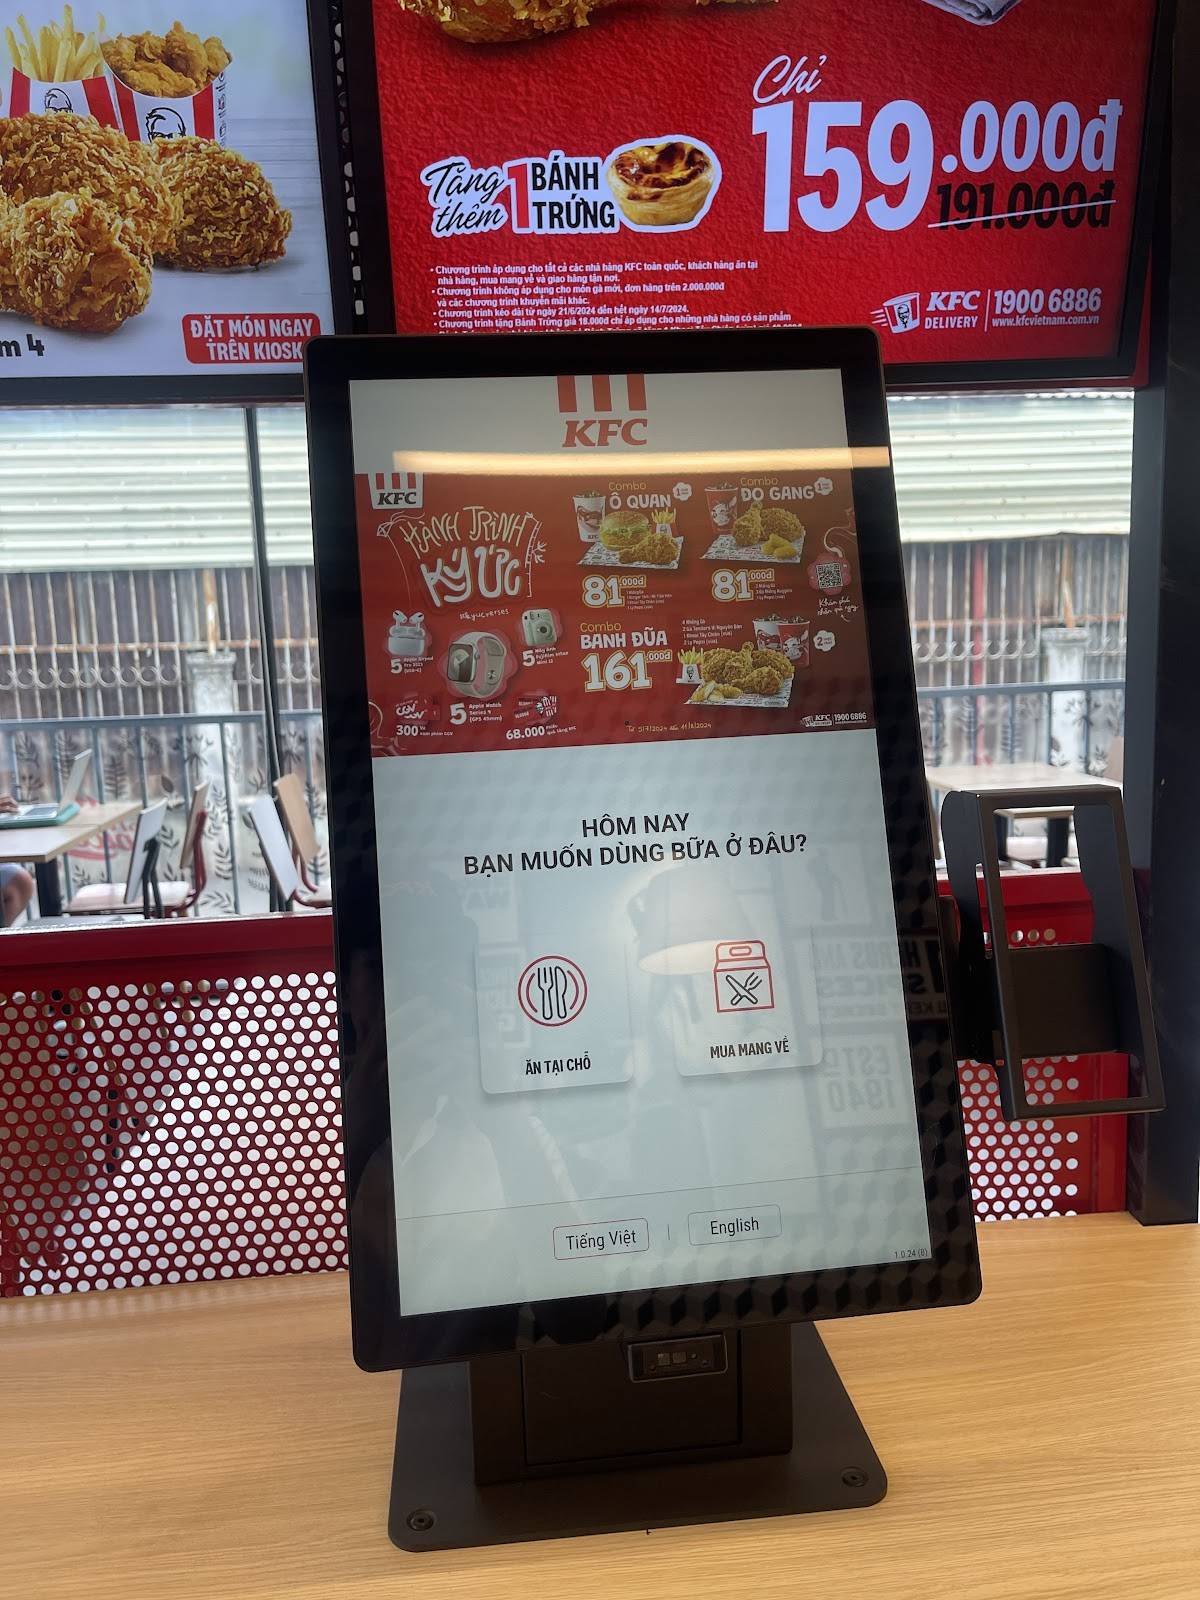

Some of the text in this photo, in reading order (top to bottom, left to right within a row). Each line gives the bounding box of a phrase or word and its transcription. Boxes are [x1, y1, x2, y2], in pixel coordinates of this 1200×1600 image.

[752, 54, 828, 104] Chỉ
[532, 155, 599, 191] BÁNH
[507, 163, 530, 229] 1
[936, 179, 1115, 230] 191.000đ
[436, 203, 503, 232] thêm
[532, 193, 615, 229] TRỨNG
[624, 262, 642, 271] KFC
[926, 290, 981, 311] KFC
[994, 287, 1102, 314] 1900 6886
[190, 315, 313, 341] ĐẶT MÓN NGAY
[924, 316, 978, 330] DELIVERY
[991, 315, 1100, 327] www.kfcvietnam.com.vn
[26, 333, 45, 356] 4
[206, 338, 303, 361] TRÊN KIOSK
[562, 418, 648, 448] KFC
[377, 491, 417, 505] KFC
[609, 491, 671, 510] Ô QUAN
[769, 485, 815, 500] GANG
[580, 633, 627, 650] BANH
[390, 658, 402, 674] 5
[522, 650, 535, 667] 5
[450, 702, 467, 725] 5
[834, 713, 849, 721] 1900
[396, 724, 419, 736] 300
[506, 725, 545, 740] 68.000
[582, 812, 690, 838] HÔM NAY
[464, 831, 807, 878] BẠN MUỐN DÙNG BỮA Ở ĐÂU?
[710, 1035, 790, 1059] MUA MANG VỀ
[526, 1050, 591, 1076] ĂN TẠI CHỖ
[710, 1216, 760, 1237] English
[566, 1229, 637, 1255] Tiếng Việt
